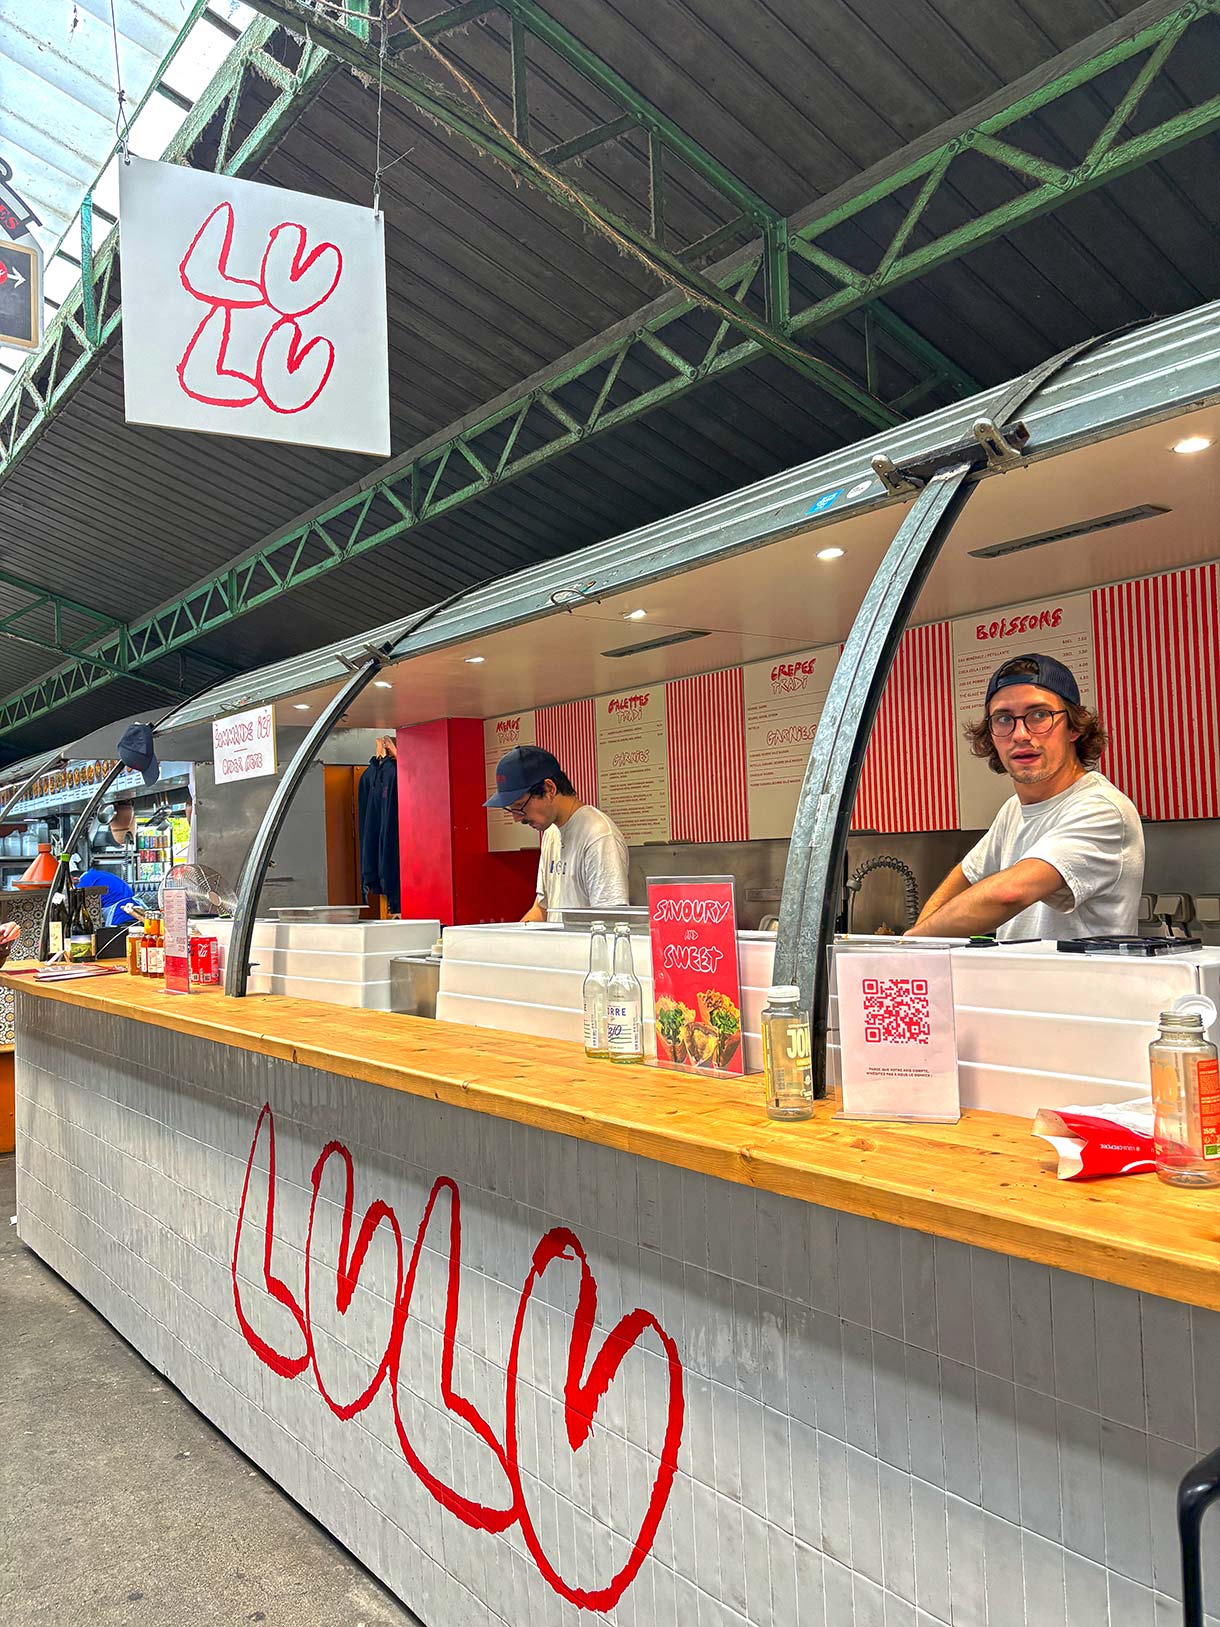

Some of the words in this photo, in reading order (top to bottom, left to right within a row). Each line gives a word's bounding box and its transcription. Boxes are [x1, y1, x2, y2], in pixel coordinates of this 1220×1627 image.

[653, 899, 731, 923] SAVOURY
[664, 944, 723, 974] SWEET
[232, 1102, 685, 1613] LULU
